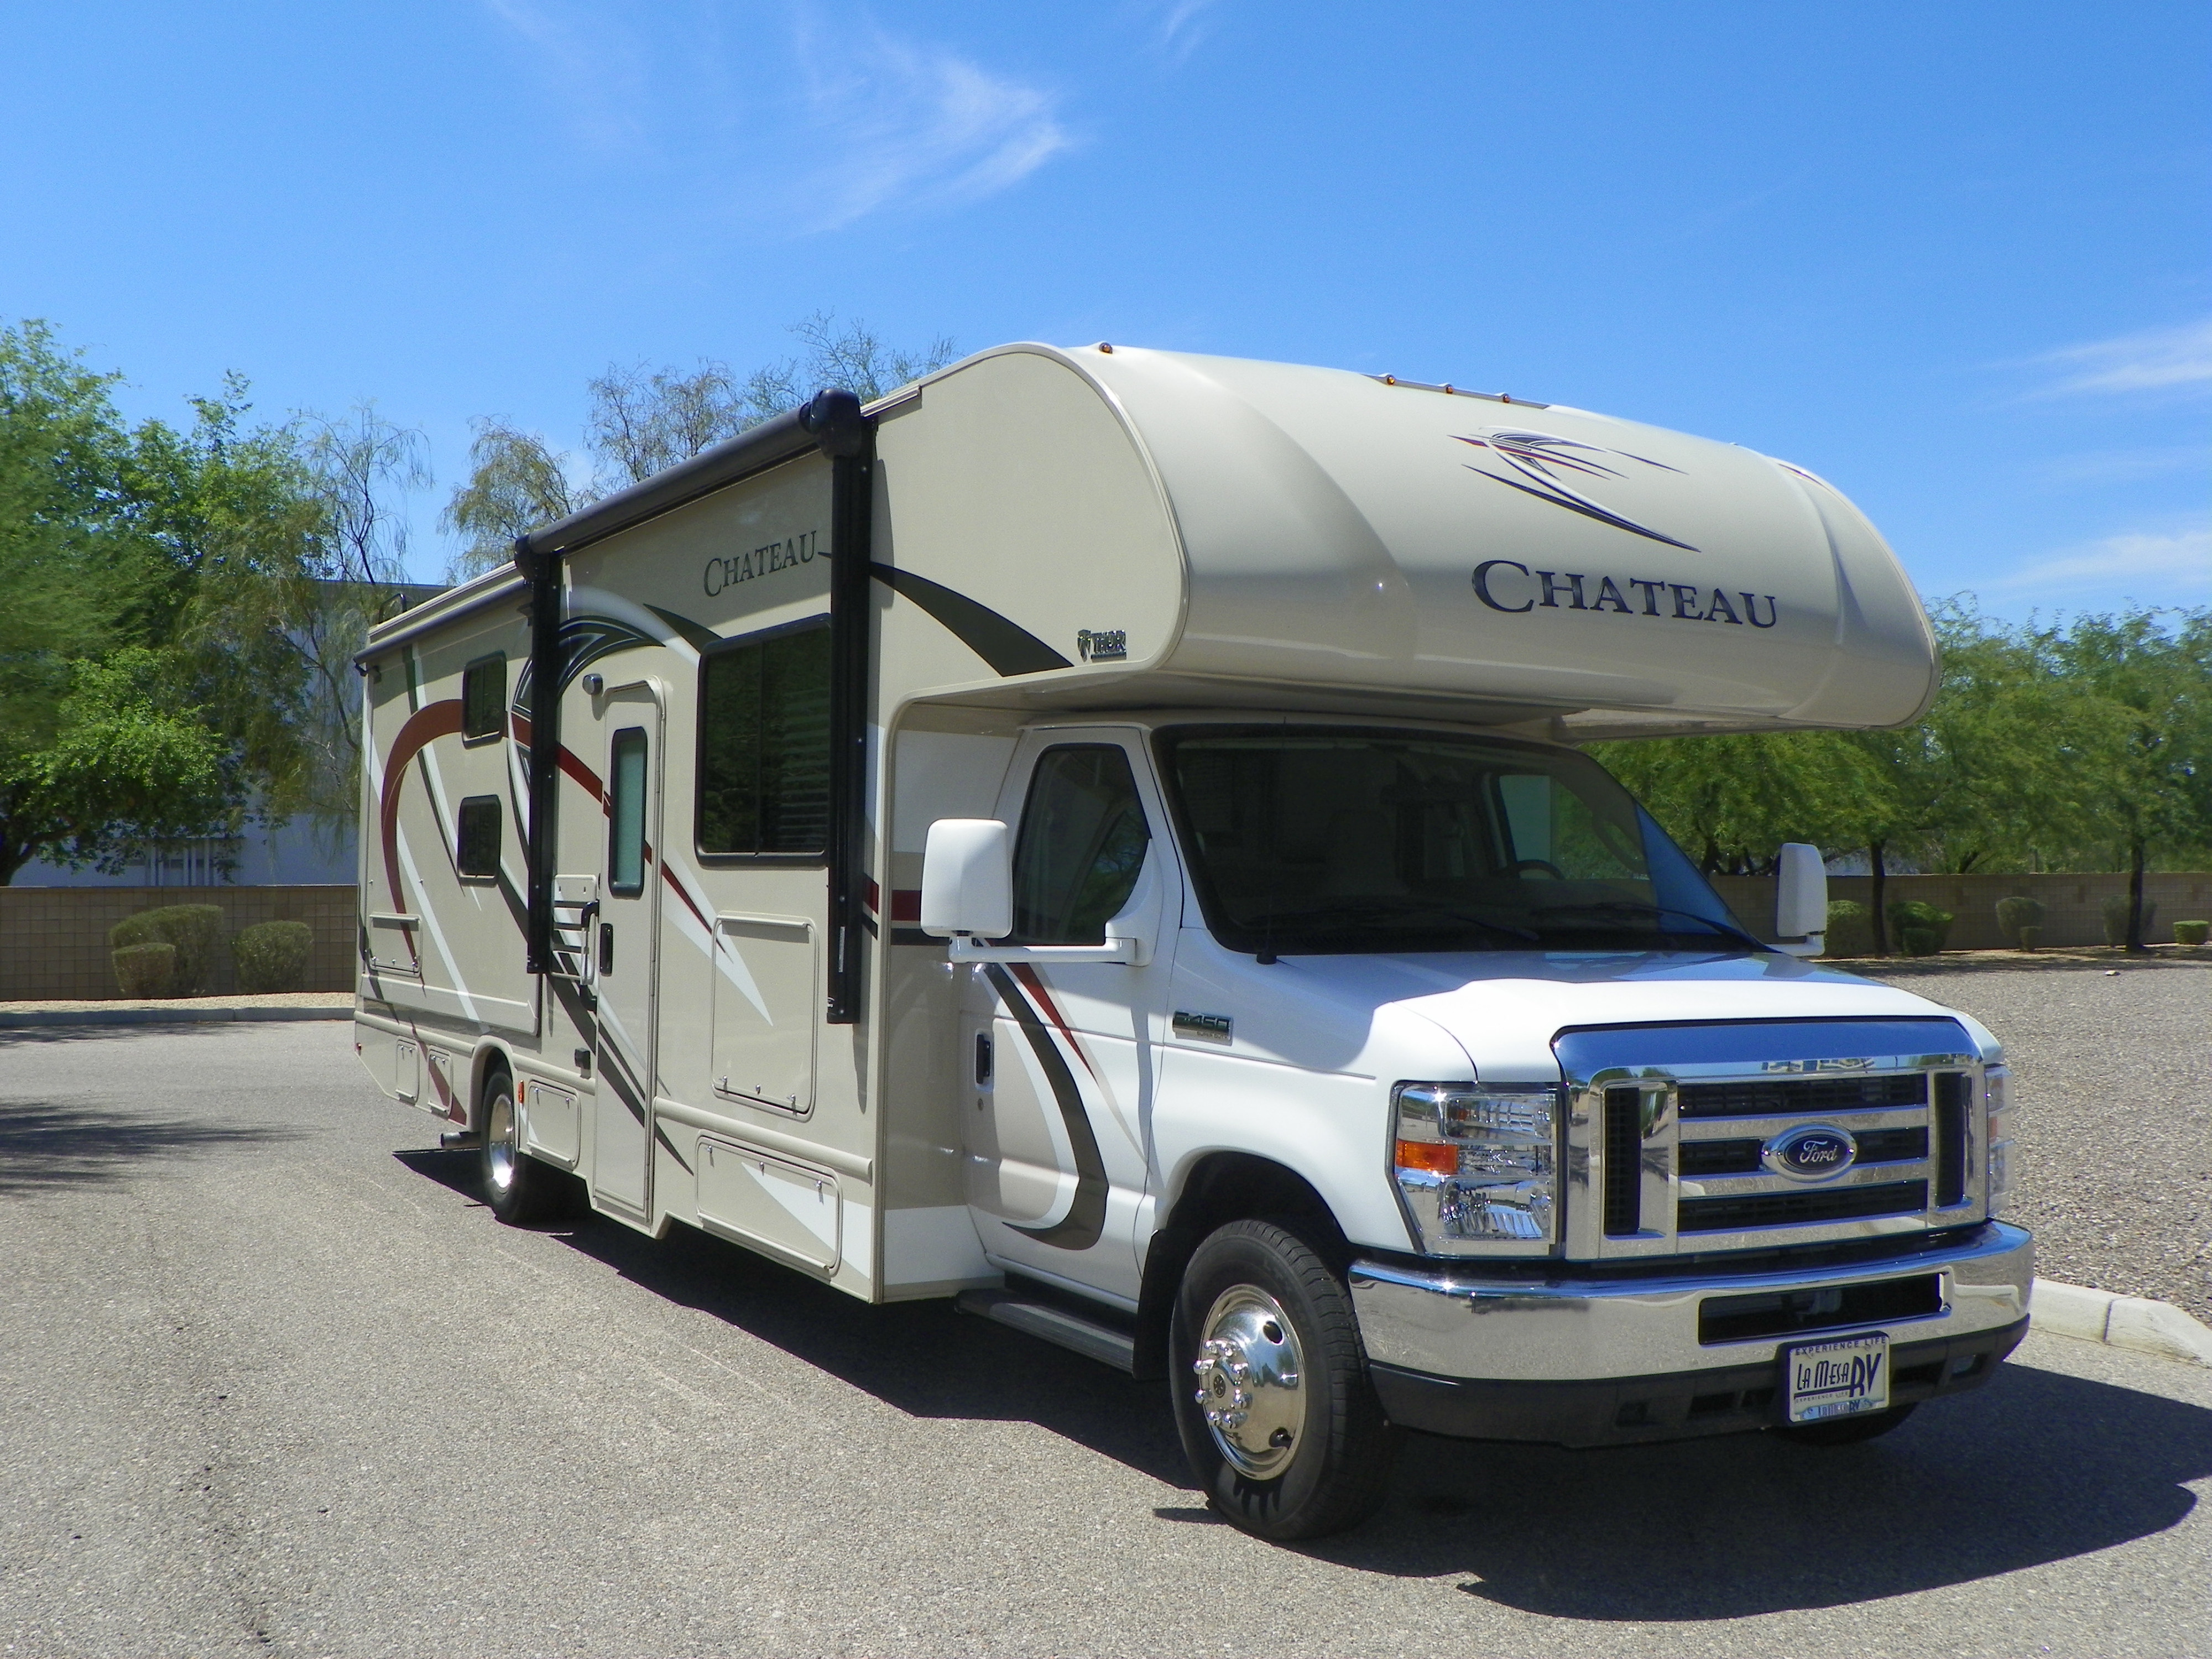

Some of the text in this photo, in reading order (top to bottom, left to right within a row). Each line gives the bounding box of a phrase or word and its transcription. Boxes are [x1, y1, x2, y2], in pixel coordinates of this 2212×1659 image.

[703, 530, 816, 597] CHATEAU
[1472, 560, 1776, 628] CHATEAU
[1799, 1140, 1838, 1164] Ford
[1796, 1336, 1886, 1355] EXPERIENCE LIFE
[1849, 1353, 1882, 1397] RV
